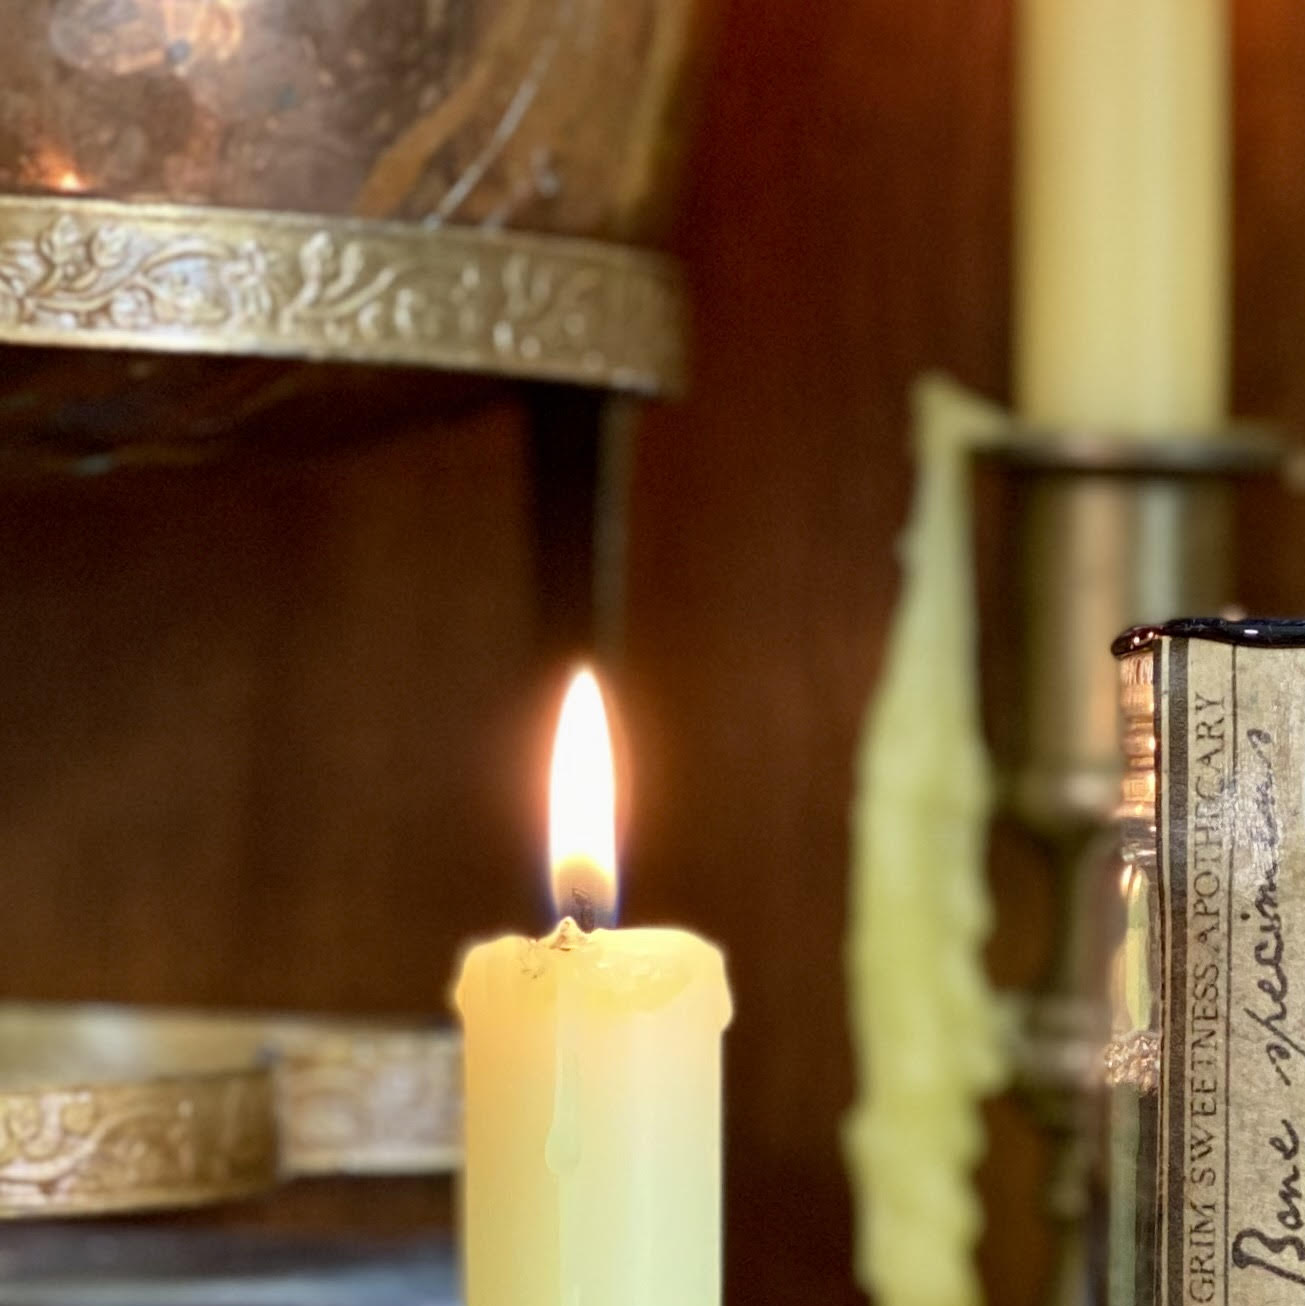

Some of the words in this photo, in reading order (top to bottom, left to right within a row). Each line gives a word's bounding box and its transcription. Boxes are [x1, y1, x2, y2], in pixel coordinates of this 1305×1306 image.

[1194, 694, 1225, 953] APOTHECARY
[1190, 963, 1220, 1186] SWEETNESS
[1188, 1201, 1217, 1303] GRIM
